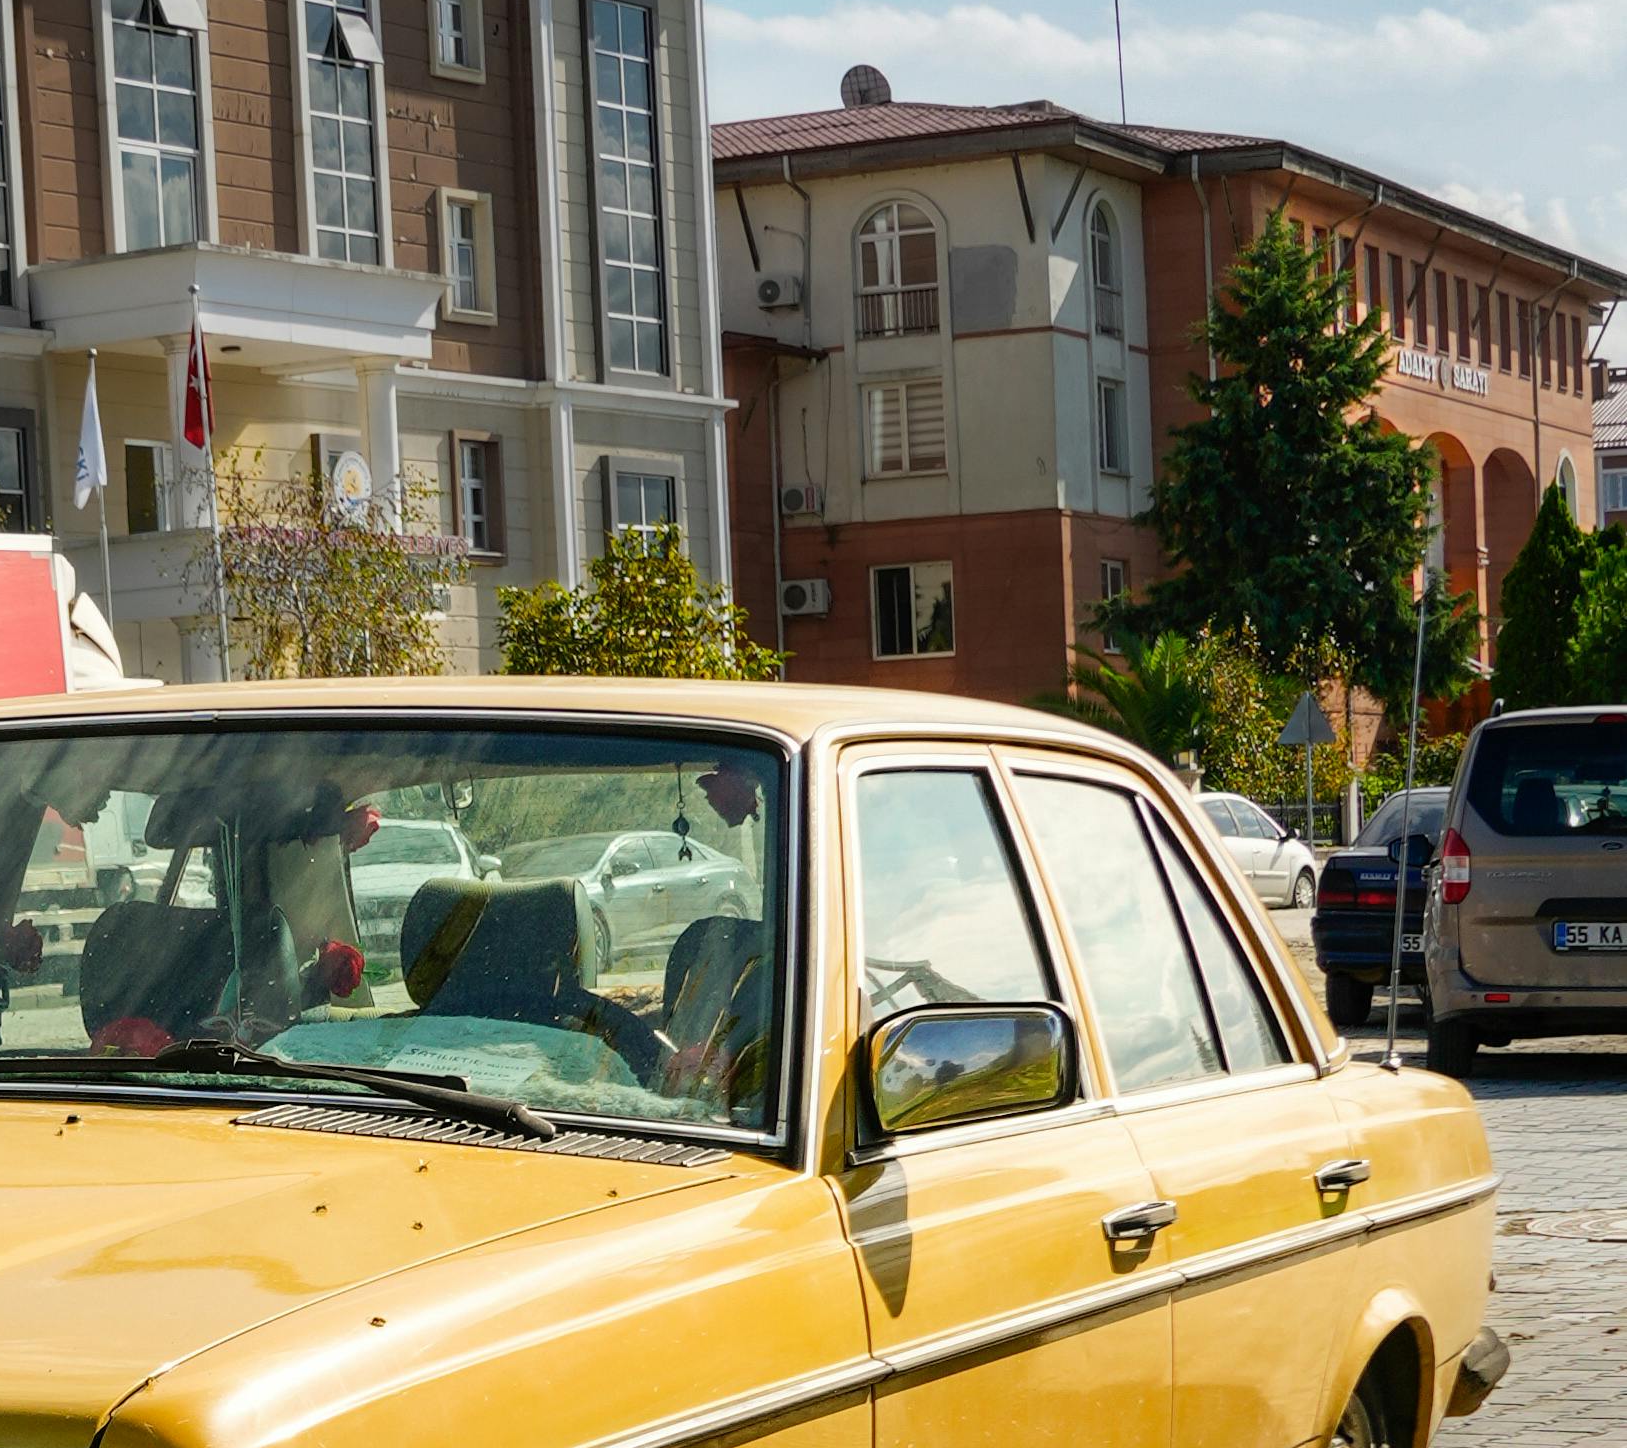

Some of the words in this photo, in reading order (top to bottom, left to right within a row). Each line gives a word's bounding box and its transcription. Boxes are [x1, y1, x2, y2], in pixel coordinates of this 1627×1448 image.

[1399, 350, 1438, 382] ADALET
[1453, 365, 1489, 395] SARAYI
[1403, 936, 1420, 950] 55
[1567, 926, 1588, 943] 55
[1599, 926, 1623, 943] KA
